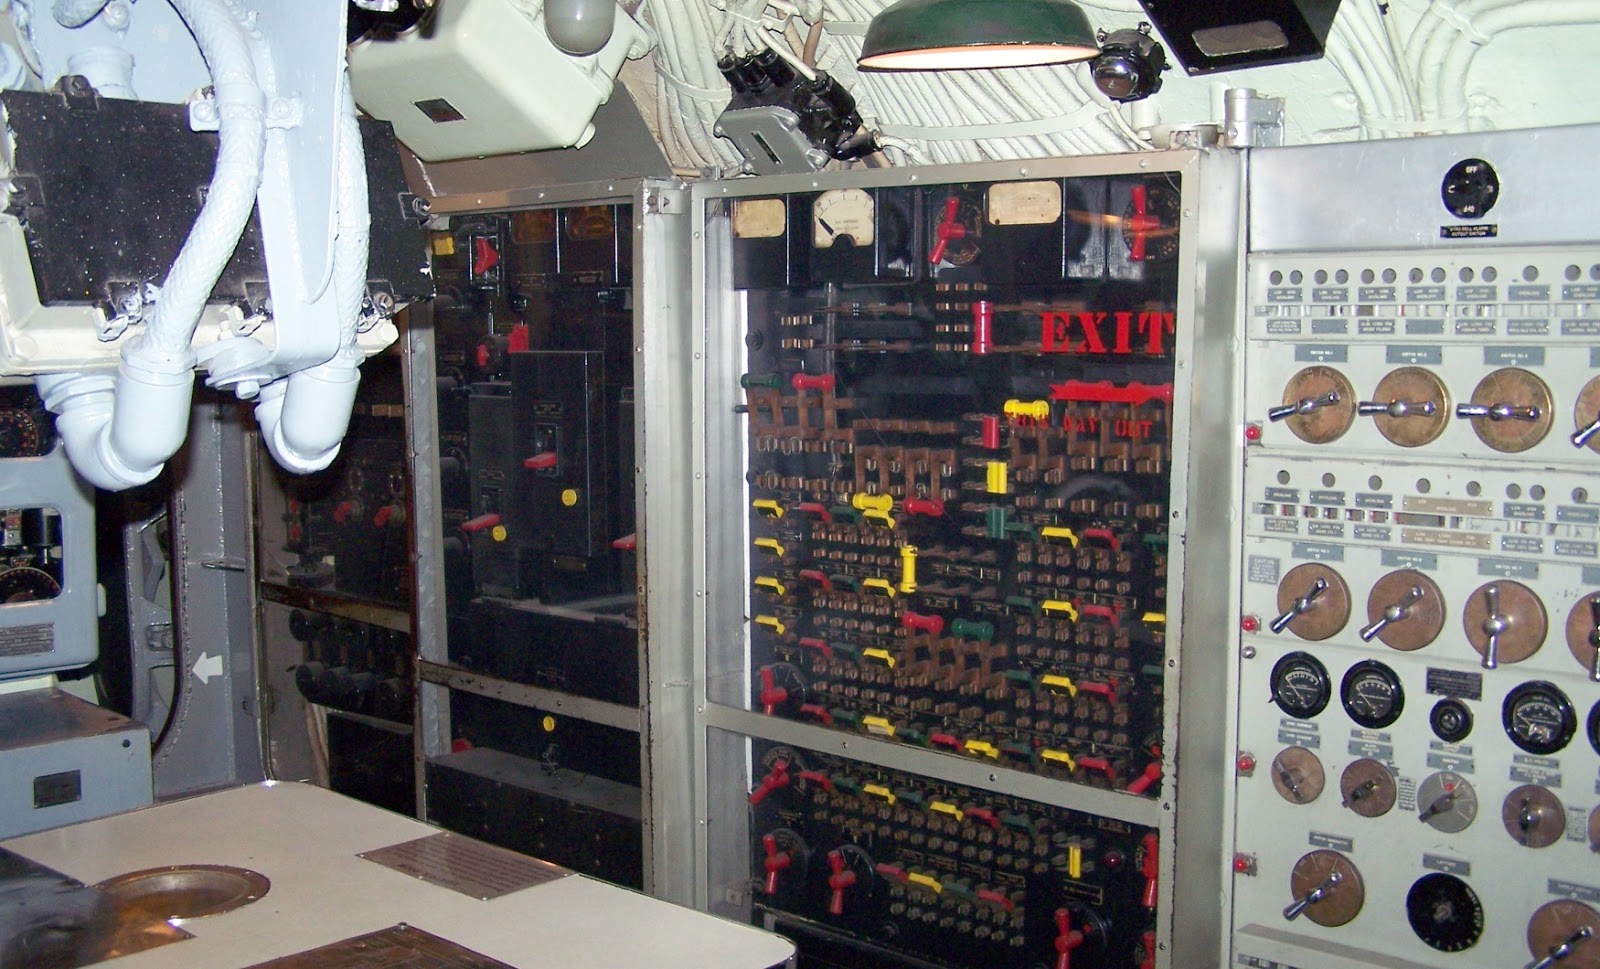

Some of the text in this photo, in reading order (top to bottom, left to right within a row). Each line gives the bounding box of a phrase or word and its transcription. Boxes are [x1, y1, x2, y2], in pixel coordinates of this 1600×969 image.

[1039, 311, 1175, 355] EXIT
[1063, 414, 1101, 433] WAY
[1114, 418, 1153, 439] OUT
